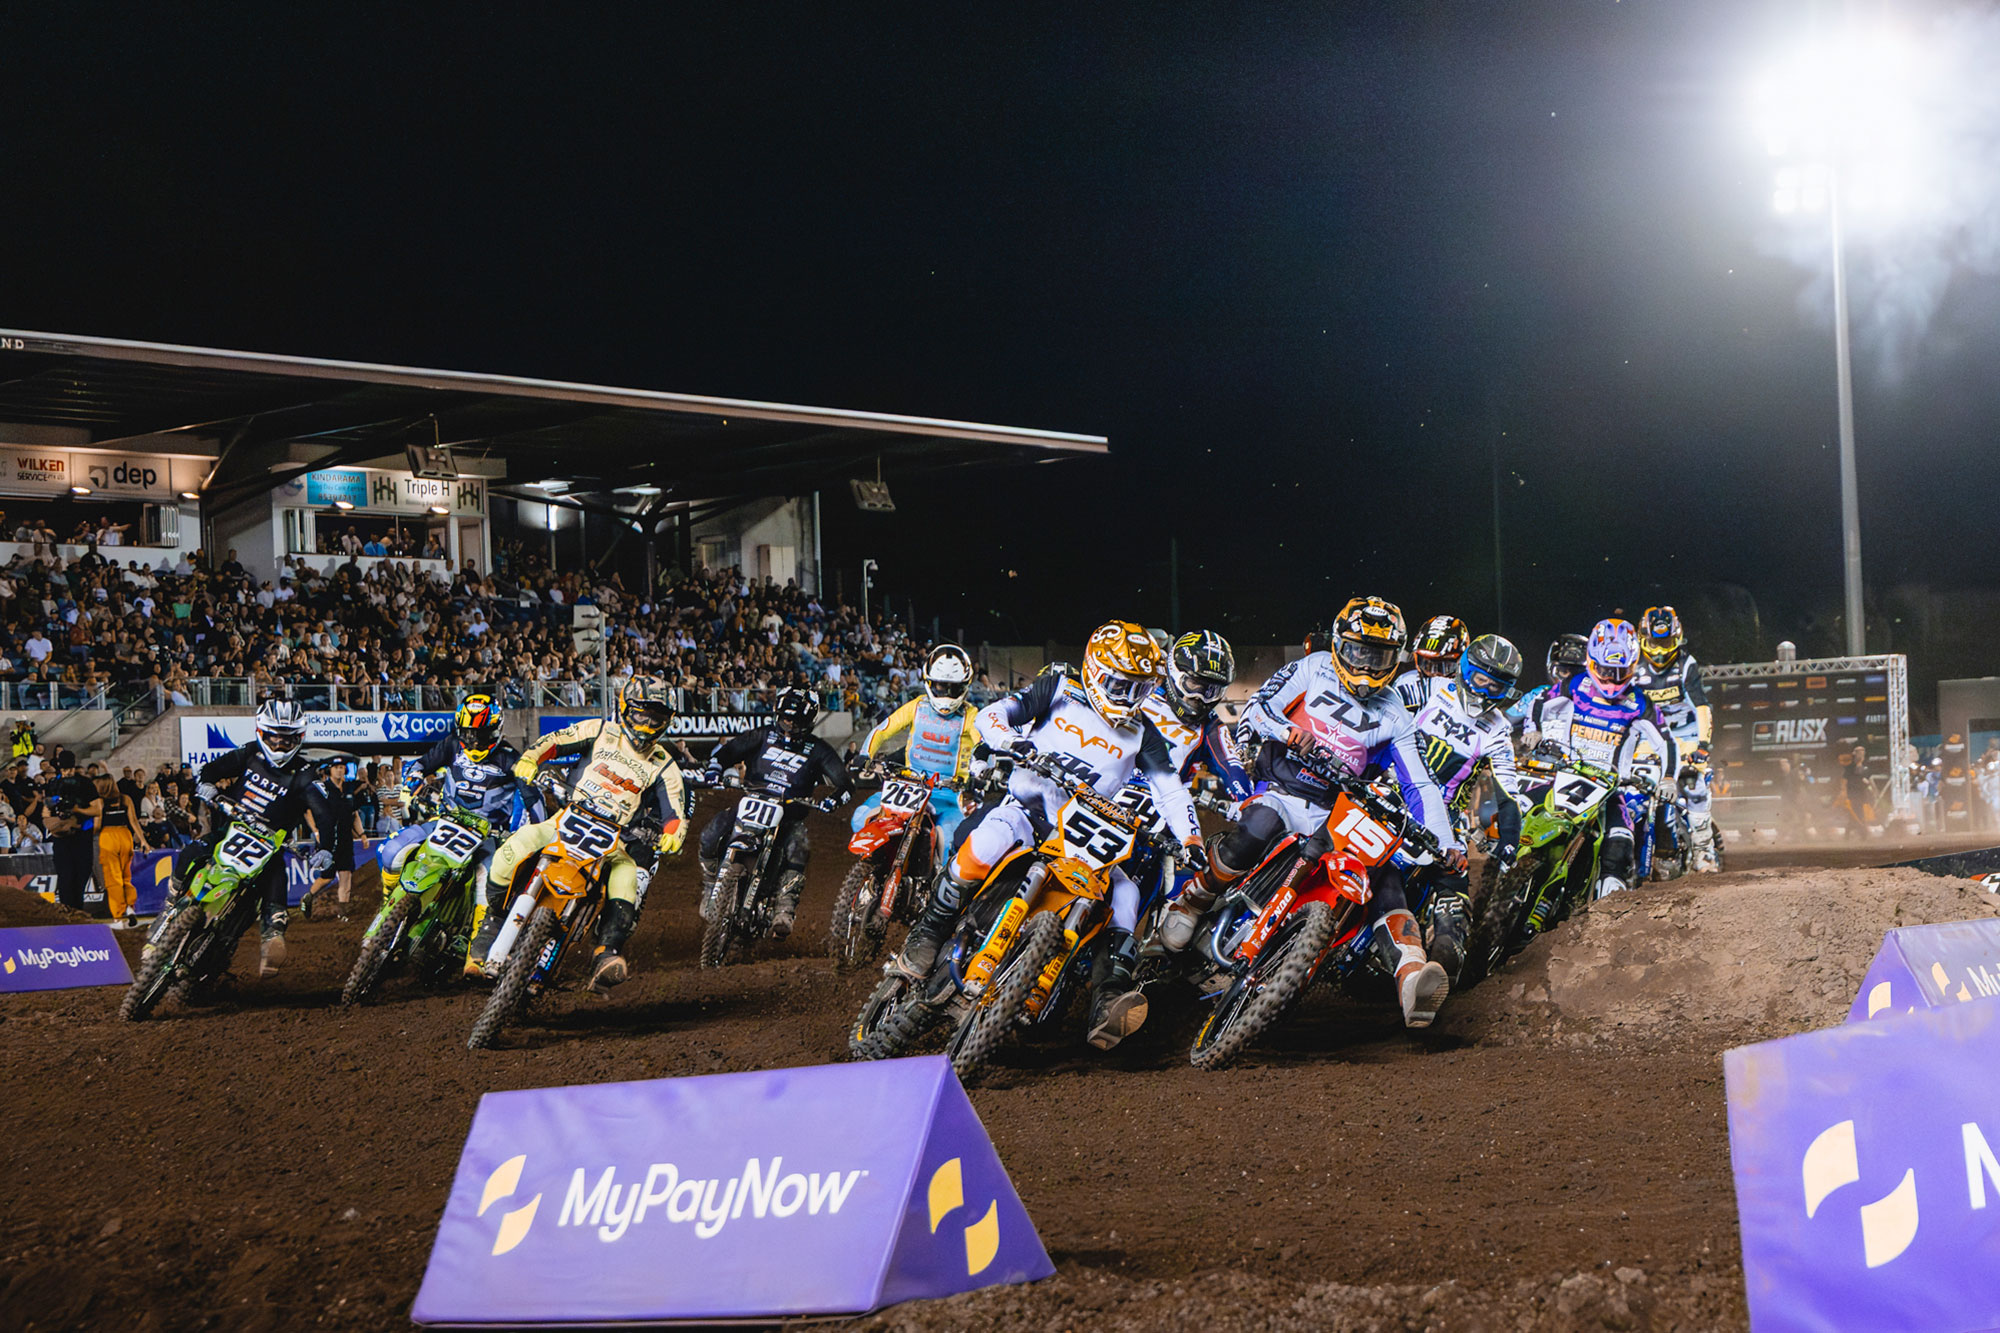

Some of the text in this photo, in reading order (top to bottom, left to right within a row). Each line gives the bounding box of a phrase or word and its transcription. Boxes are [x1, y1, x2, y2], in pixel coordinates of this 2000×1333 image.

[113, 461, 157, 490] dep
[404, 479, 450, 498] Triple H
[322, 716, 343, 727] your
[345, 714, 353, 724] IT
[355, 714, 378, 727] goals
[667, 716, 774, 734] ODULARWALLS
[1309, 690, 1382, 733] FLY
[313, 728, 369, 738] acorp.net.au
[1570, 724, 1623, 747] PENRITE
[1775, 718, 1829, 744] AUSX
[762, 746, 808, 769] SFC
[1334, 748, 1360, 767] STAR
[244, 768, 288, 797] FORTH
[1557, 779, 1599, 806] 4
[881, 783, 928, 811] 262
[741, 799, 777, 827] 20
[429, 823, 478, 863] 32
[559, 815, 615, 858] 52
[1063, 810, 1128, 865] 53
[1334, 808, 1394, 859] 15
[222, 832, 269, 868] 82
[18, 946, 111, 970] MyPayNow
[557, 1157, 868, 1243] MyPayNow
